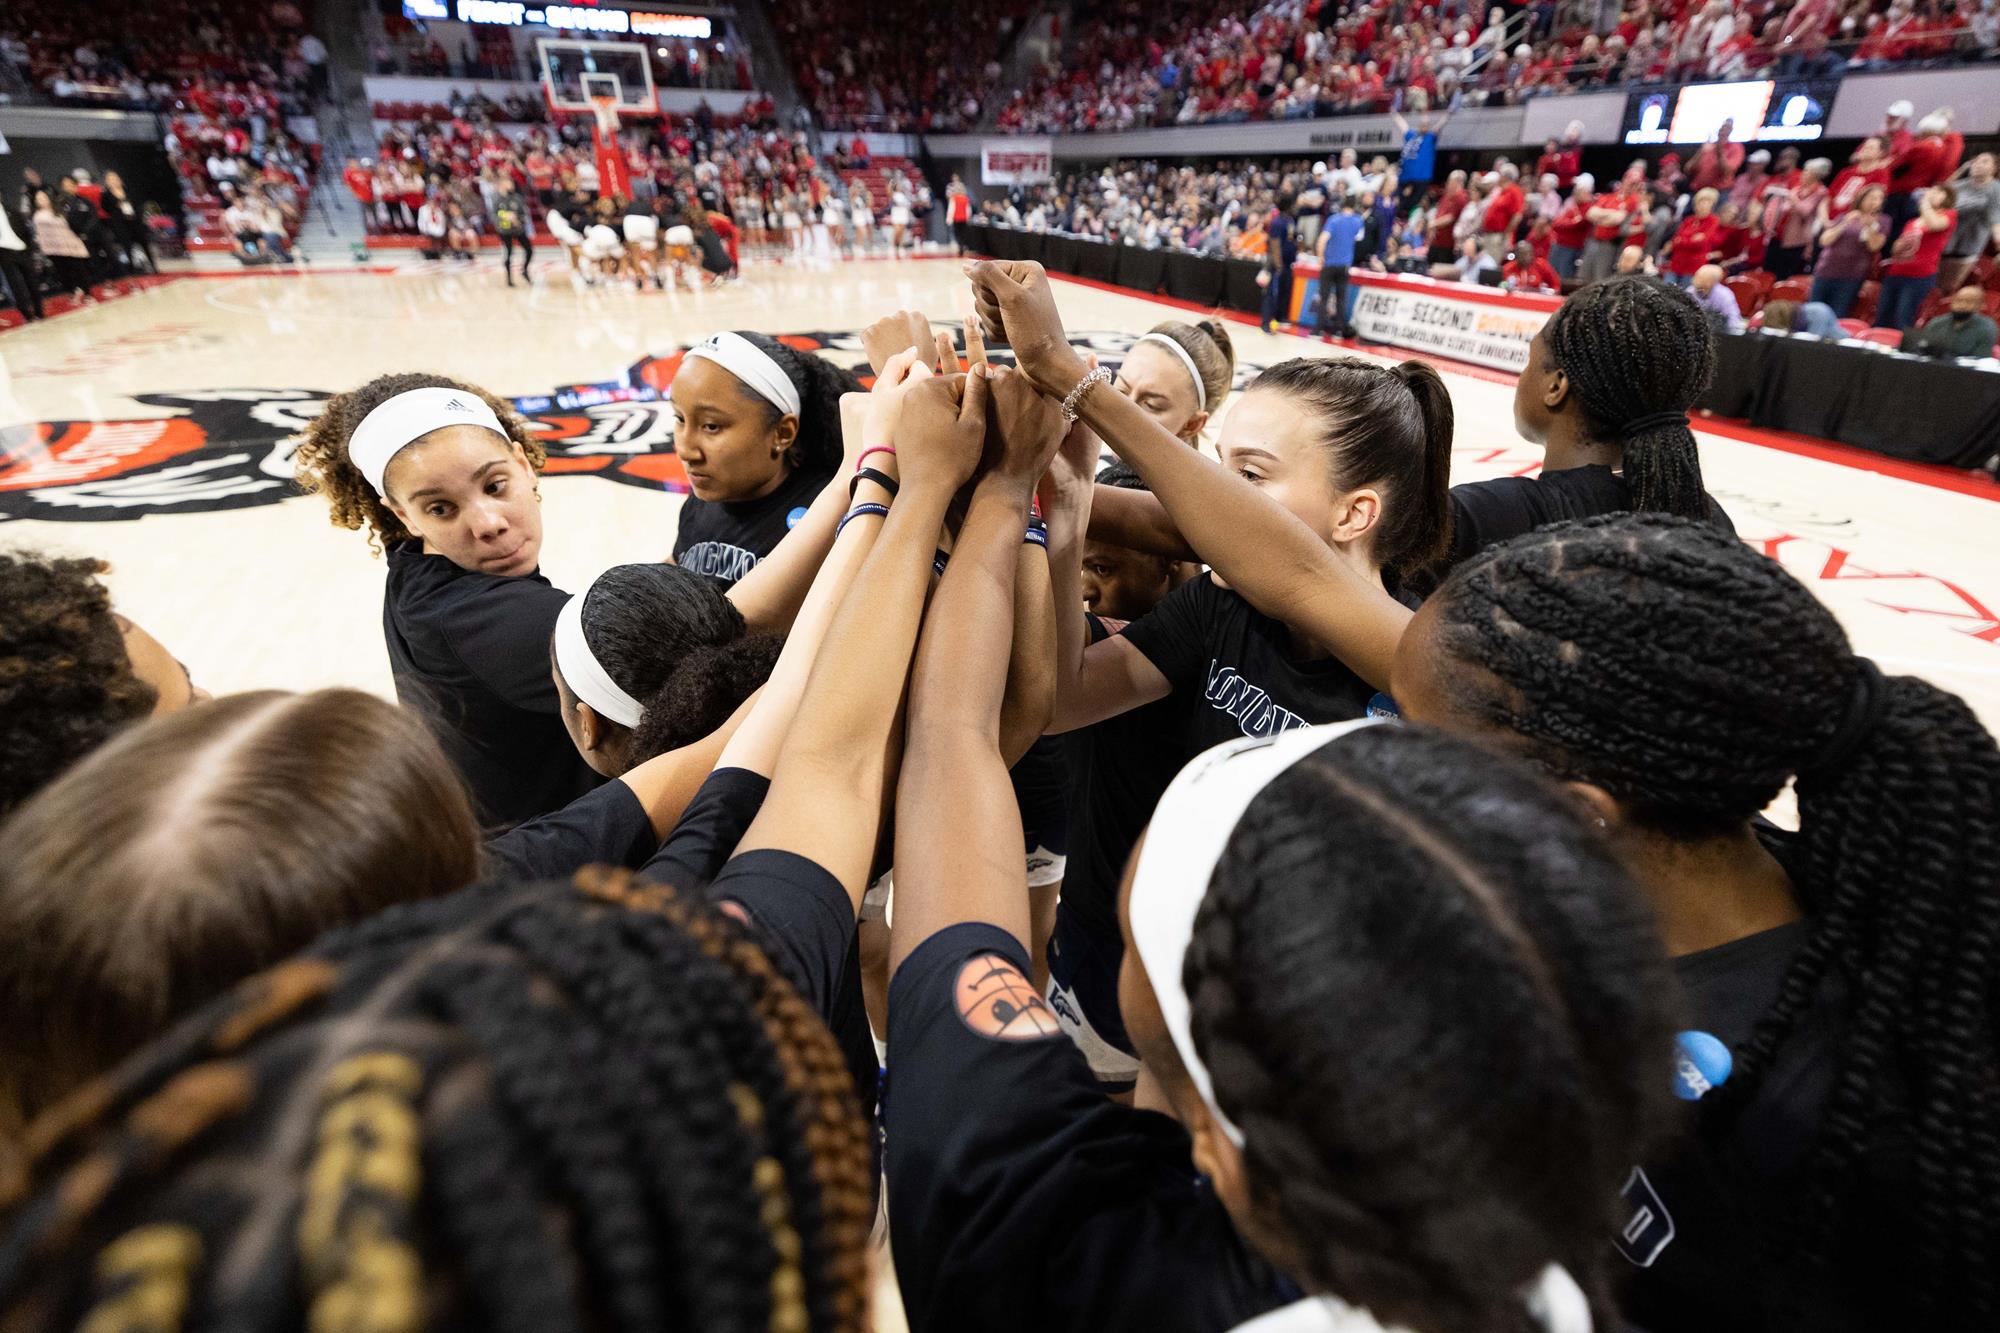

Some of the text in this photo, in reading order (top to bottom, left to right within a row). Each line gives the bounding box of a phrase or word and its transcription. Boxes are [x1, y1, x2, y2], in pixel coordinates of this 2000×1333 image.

[988, 152, 1047, 171] ESPN
[1360, 293, 1539, 343] FIRST SECOND ROUND
